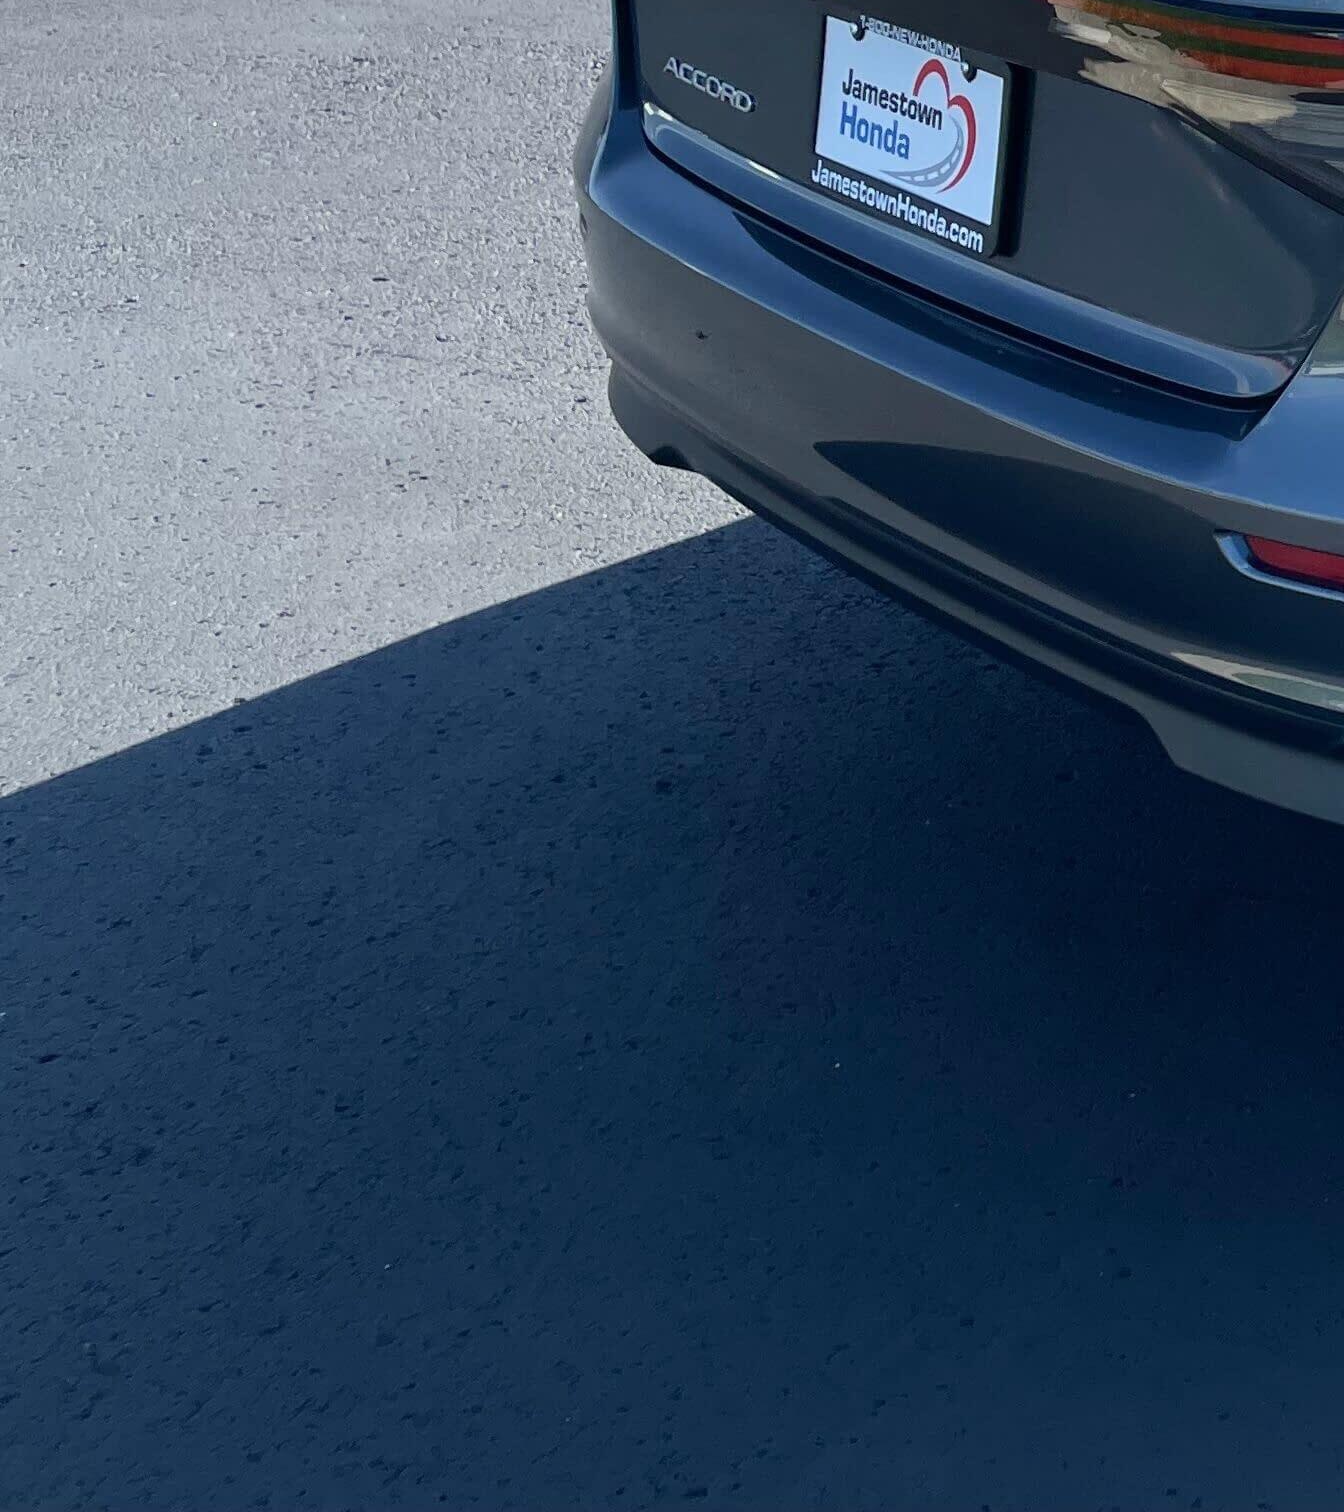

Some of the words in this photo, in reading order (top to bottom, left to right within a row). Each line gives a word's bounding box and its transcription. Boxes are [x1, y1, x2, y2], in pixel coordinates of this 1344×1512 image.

[663, 56, 753, 113] ACCORD
[841, 68, 943, 130] Jamestown
[839, 100, 910, 160] Honda
[811, 159, 984, 254] JamestownHonda.com
